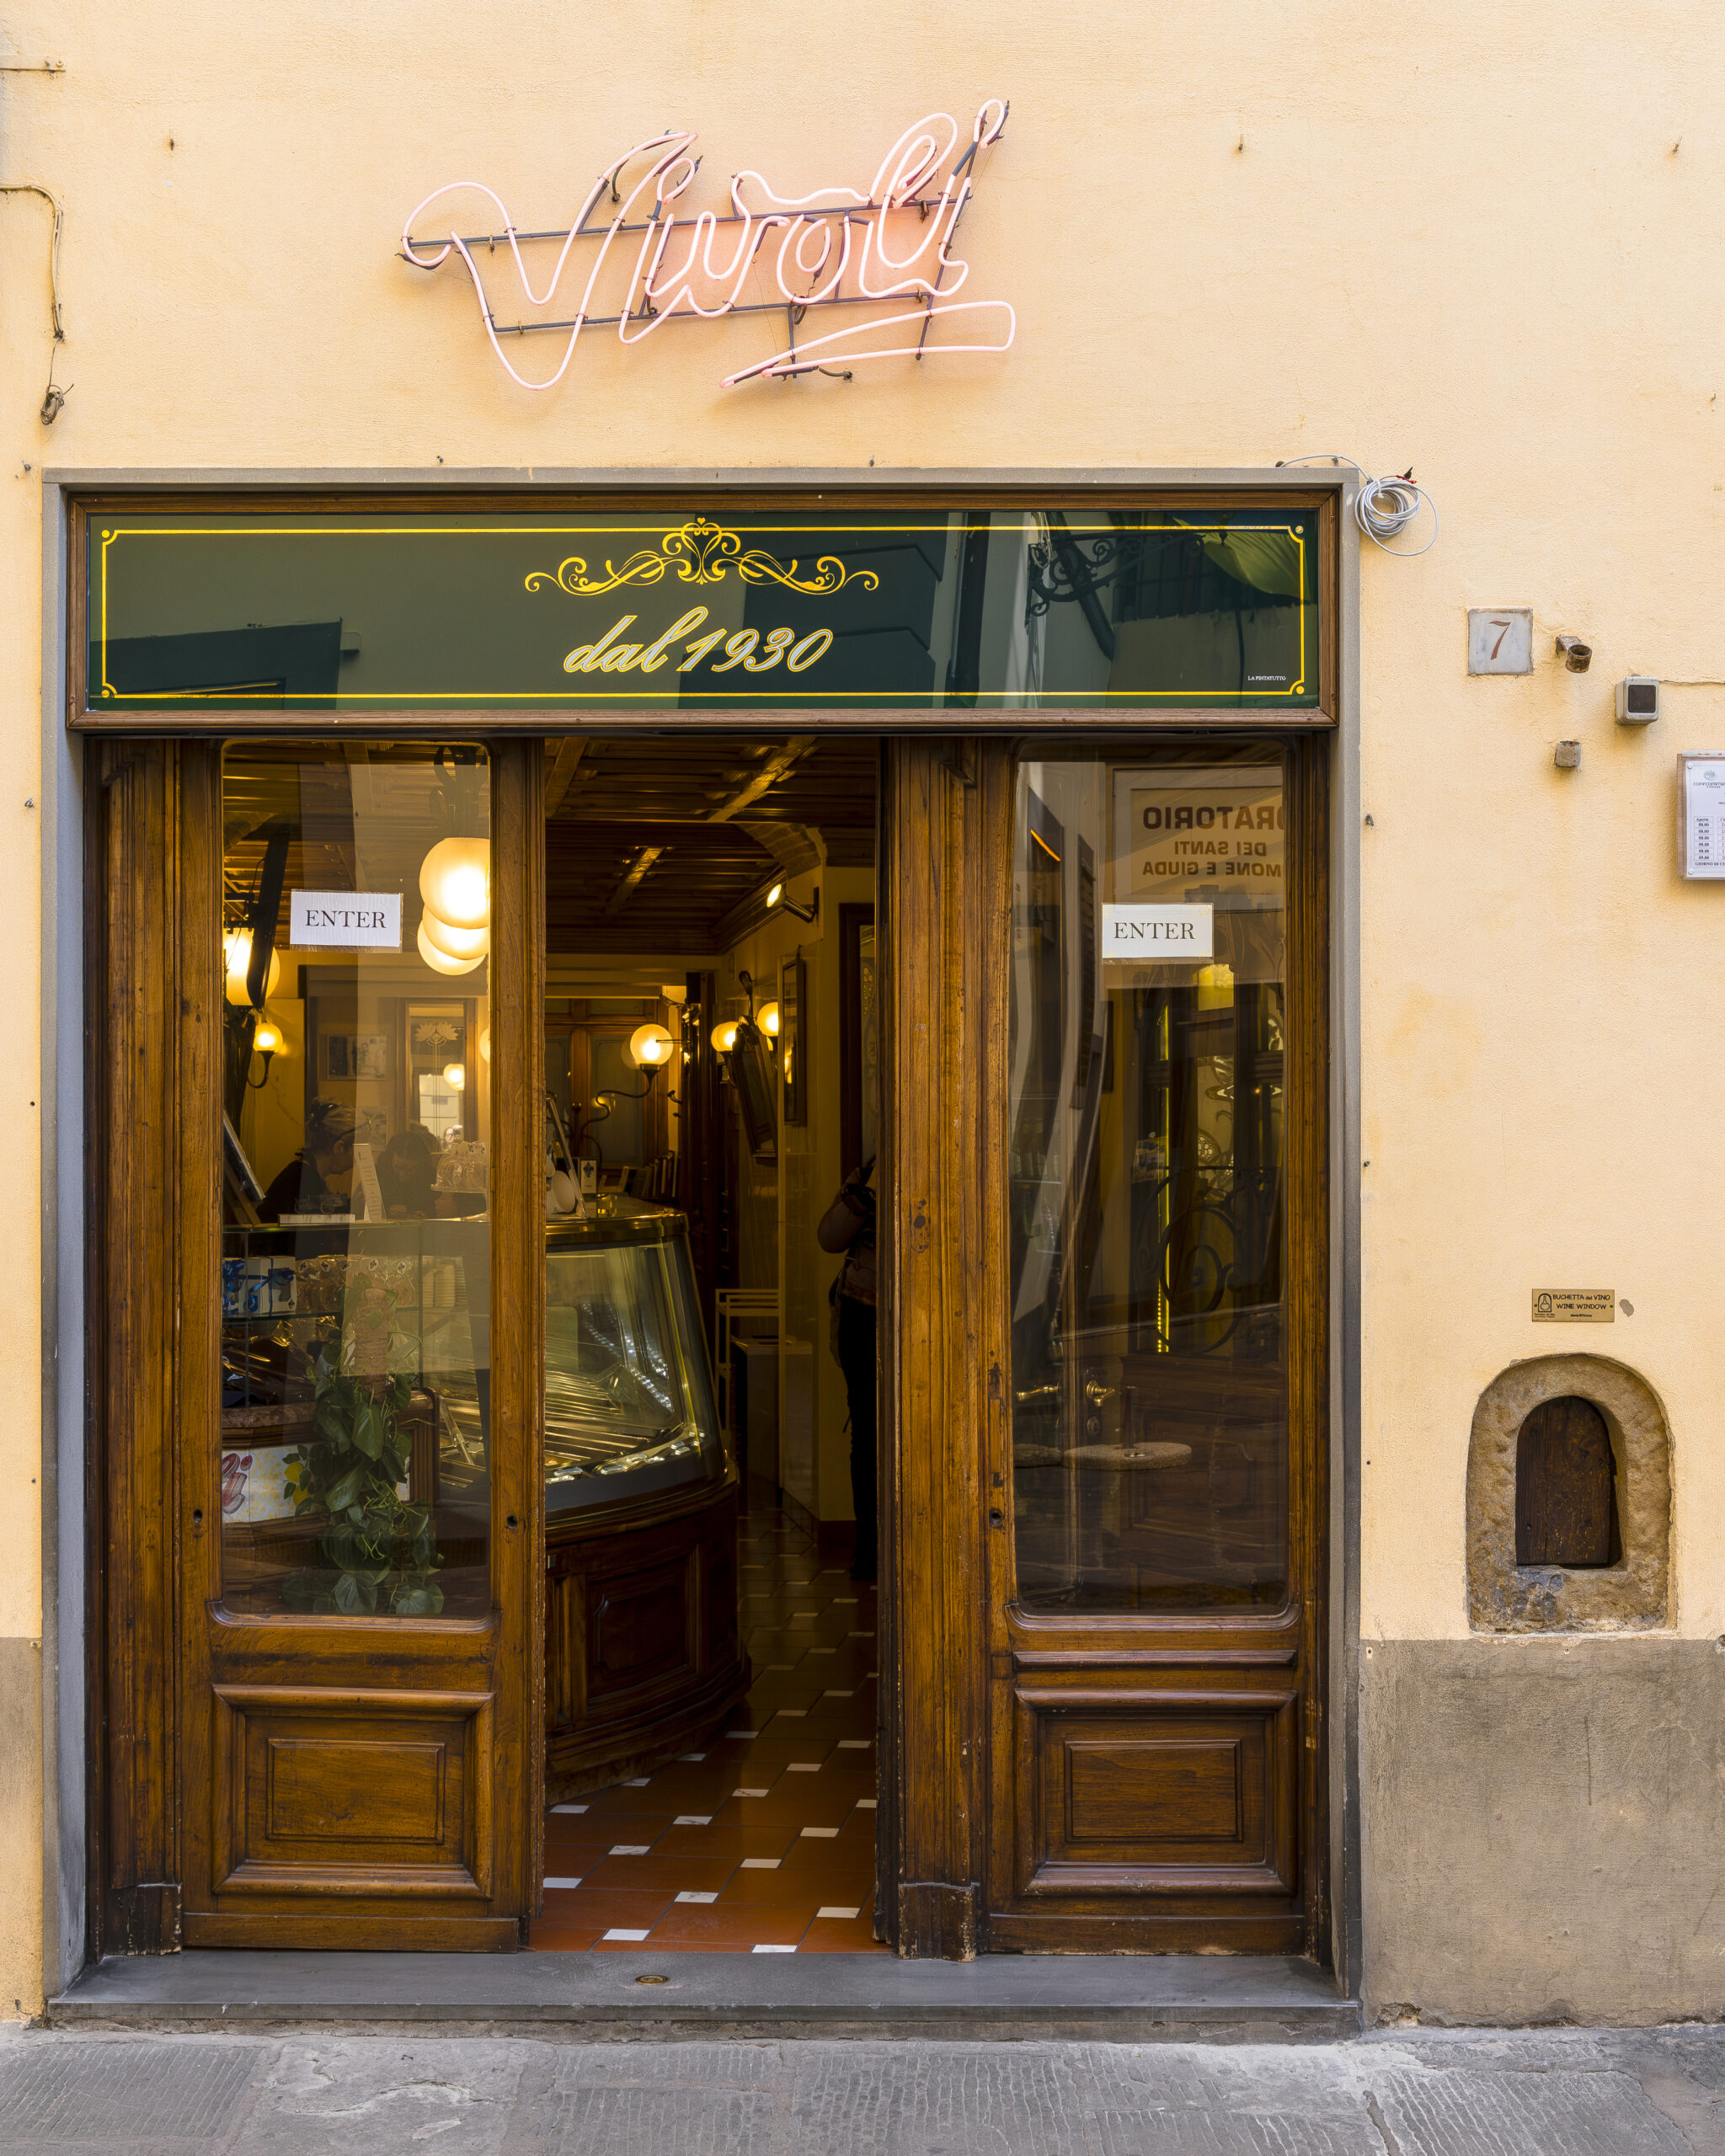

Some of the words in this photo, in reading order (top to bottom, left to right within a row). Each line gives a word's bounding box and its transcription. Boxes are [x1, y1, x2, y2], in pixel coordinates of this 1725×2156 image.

[400, 99, 1008, 391] Vivoli
[563, 606, 709, 673] dal
[676, 627, 834, 672] 1930
[1488, 620, 1512, 661] 7
[305, 910, 387, 929] ENTER
[1113, 921, 1196, 940] ENTER
